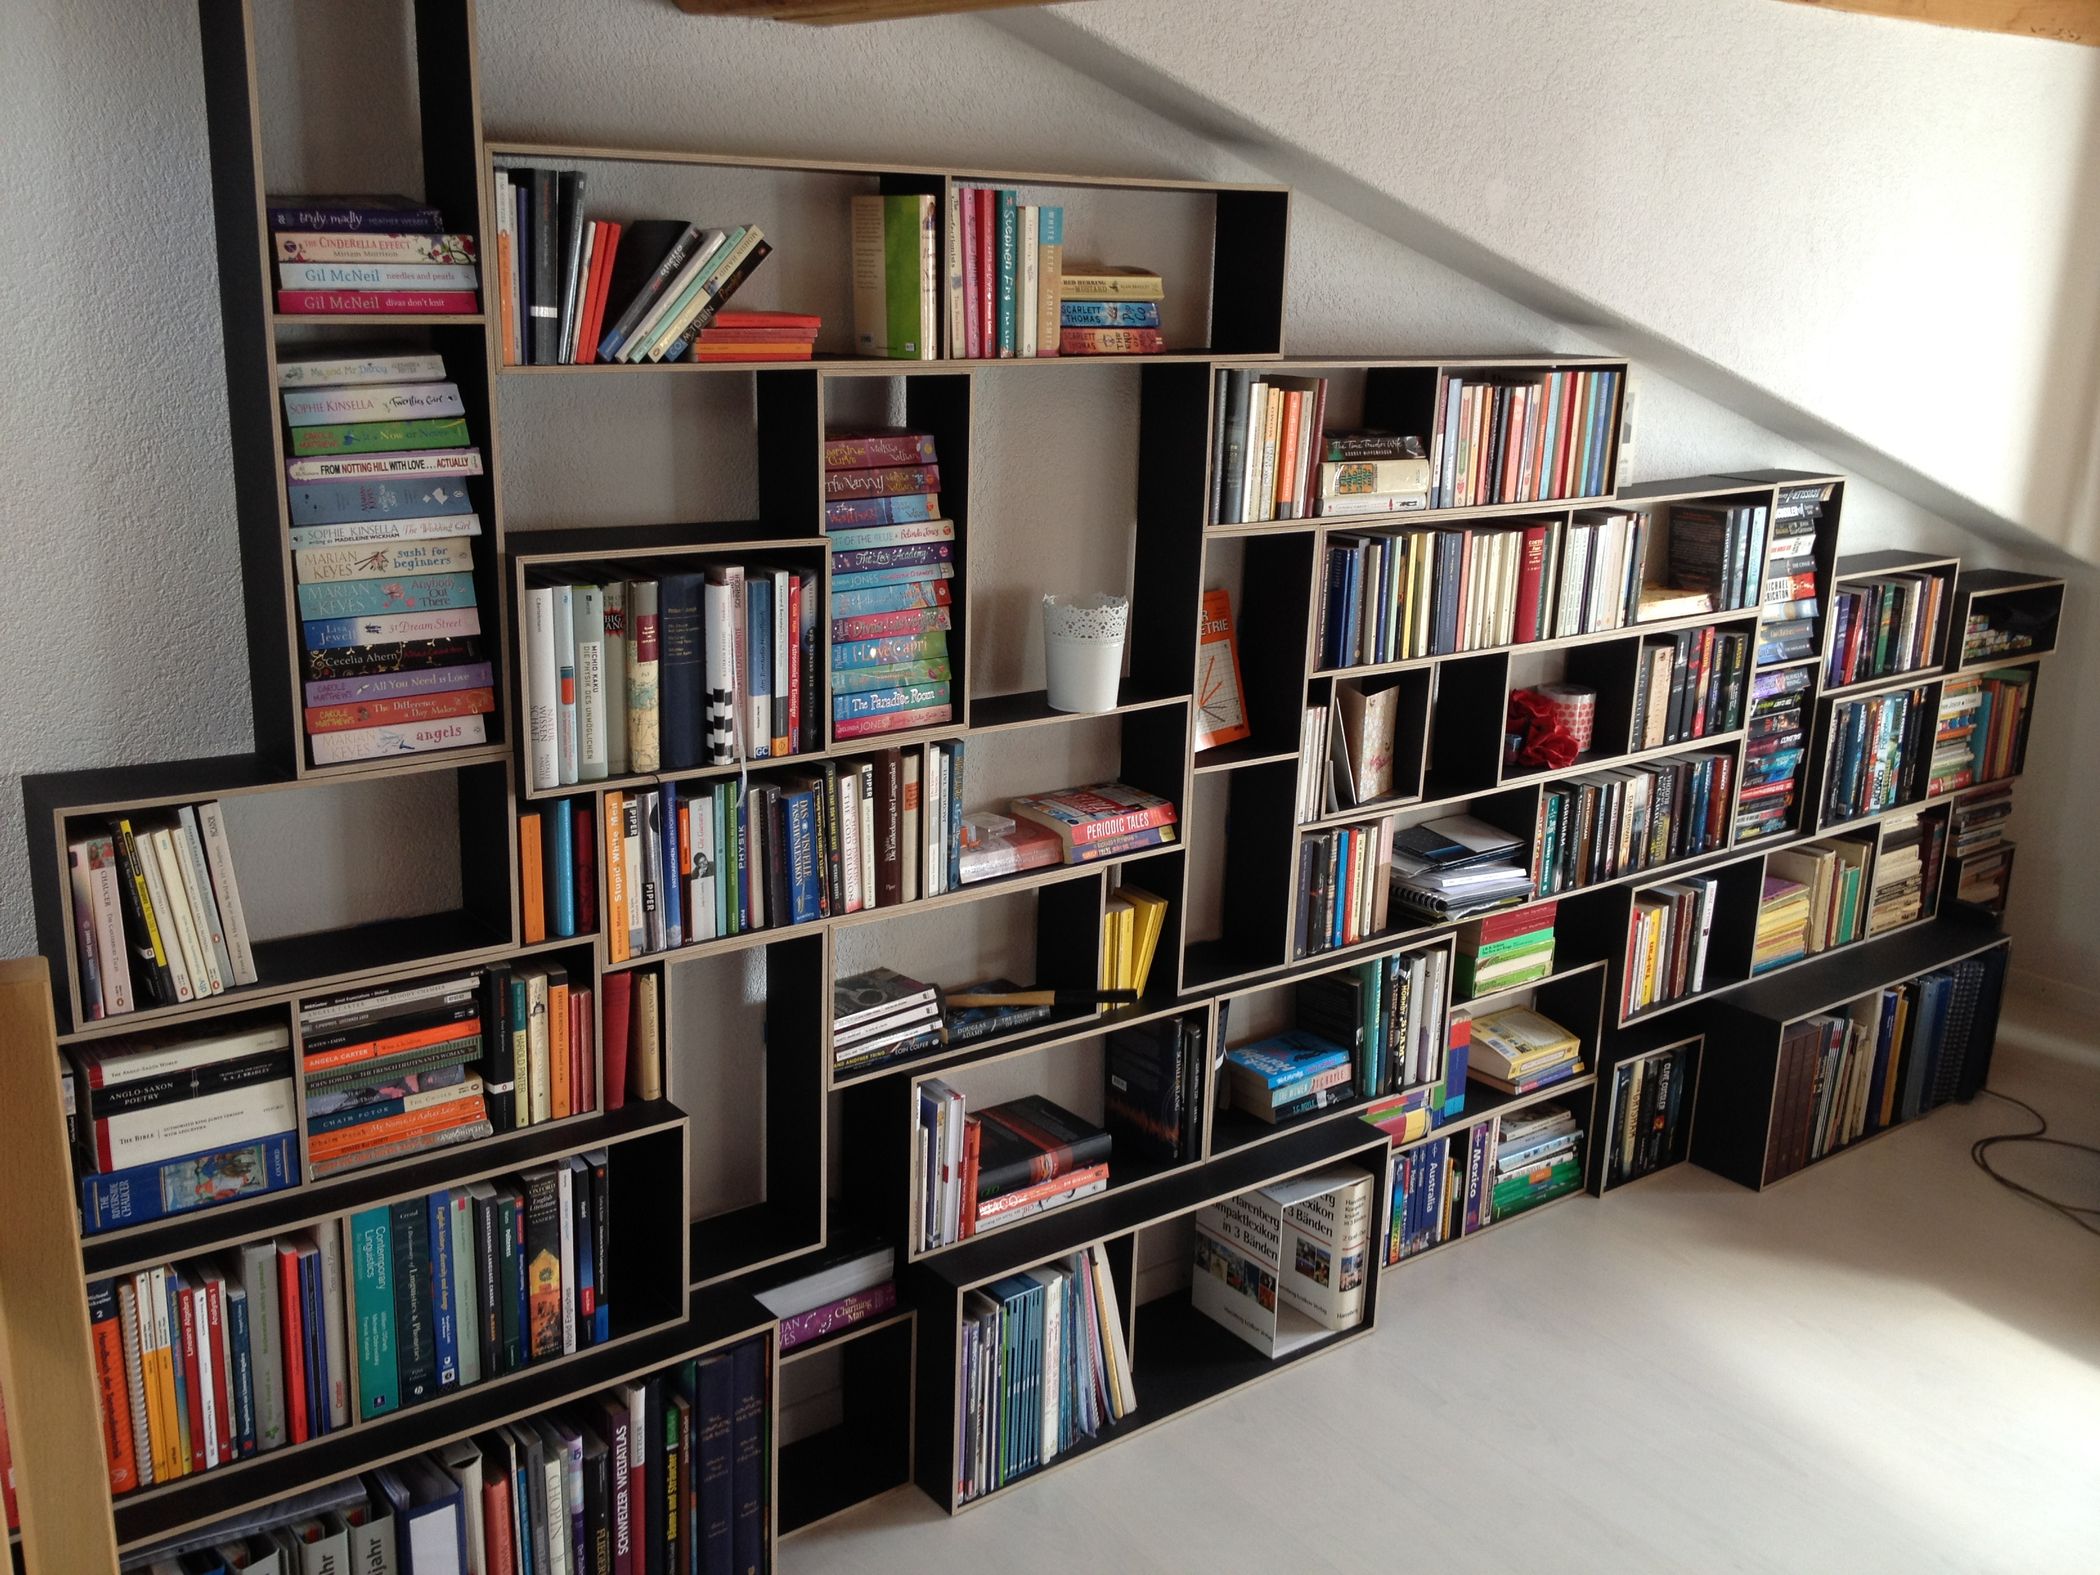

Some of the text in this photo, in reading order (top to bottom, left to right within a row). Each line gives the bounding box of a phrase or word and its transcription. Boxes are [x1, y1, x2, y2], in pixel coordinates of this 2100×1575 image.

[300, 211, 363, 229] truly madly
[1048, 211, 1056, 241] WHITE
[319, 237, 377, 249] CINDERELLA
[1003, 209, 1015, 301] Stephen Fry
[305, 269, 326, 282] Gil
[330, 268, 380, 282] McNeil
[416, 272, 429, 280] and
[304, 296, 325, 310] Gil
[329, 296, 380, 310] McNeil
[1061, 305, 1101, 314] SCARLETT
[1065, 315, 1101, 323] THOMAS
[290, 399, 375, 414] SOPHIE KINSELLA
[320, 464, 341, 475] FROM
[341, 463, 372, 473] NOTTING
[373, 462, 388, 472] HILL
[389, 461, 406, 471] WITH
[436, 457, 469, 468] ACTUALLY
[308, 524, 399, 539] SOPHIE KINSELLA
[304, 551, 358, 566] MARIAN
[397, 546, 447, 557] sushi for
[314, 564, 353, 580] KEYES
[393, 556, 451, 571] beginners
[850, 575, 880, 588] JONES
[308, 583, 370, 600] MARIAN
[319, 600, 366, 617] KEYES
[400, 619, 434, 633] Dream
[604, 614, 622, 623] BIG
[326, 624, 348, 634] Lisa
[326, 651, 398, 667] Cecelia Ahern
[584, 658, 592, 688] PHYSIK
[373, 682, 387, 692] All
[389, 679, 408, 690] You
[411, 675, 437, 687] Need
[852, 698, 869, 712] The
[870, 691, 910, 710] Paradise
[531, 704, 540, 743] SCHAFT
[416, 725, 463, 743] angels
[755, 747, 769, 757] GC
[610, 802, 619, 826] Men
[628, 808, 638, 837] PIPER
[1086, 812, 1149, 840] PERIODIC TALES
[1561, 803, 1570, 846] GRISHAM
[1624, 812, 1632, 843] BROWN
[738, 824, 746, 870] PHYSIK
[800, 800, 812, 878] DAS VISUELLE
[101, 870, 111, 907] CHAUCER
[615, 865, 623, 902] Stupid
[645, 883, 655, 912] PIPER
[957, 1022, 987, 1035] DOUGLAS
[962, 1029, 984, 1039] ADAMS
[330, 1037, 346, 1045] EMMA
[1399, 1019, 1407, 1057] SLAM
[309, 1049, 369, 1067] ANGELA CARTER
[848, 1050, 886, 1065] ANOTHER THING
[310, 1080, 328, 1089] JOHN
[441, 1050, 465, 1060] WOMAN
[1326, 1069, 1345, 1085] BOYLE
[124, 1092, 160, 1106] POETRY
[1301, 1099, 1316, 1112] BOYLE
[322, 1106, 389, 1128] CHAIM POTOK
[1629, 1092, 1641, 1141] GRISHAM
[120, 1132, 155, 1146] THE BIBLE
[1409, 1169, 1417, 1194] Poland
[1469, 1147, 1483, 1199] Mexico
[1426, 1162, 1438, 1213] Australia
[101, 1195, 109, 1211] THE
[112, 1181, 120, 1220] RIVERSIDE
[121, 1179, 131, 1217] CHAUCER
[1232, 1193, 1280, 1231] Harenberg
[1288, 1206, 1294, 1217] 3
[1296, 1209, 1333, 1238] Bänden
[1223, 1219, 1278, 1261] in 3 Bänden
[364, 1229, 374, 1278] Linguistics
[375, 1226, 386, 1290] Contemporary
[96, 1310, 104, 1319] 2
[211, 1295, 219, 1327] Analysis
[835, 1299, 873, 1318] Charming
[848, 1309, 865, 1323] Man
[181, 1295, 194, 1357] Lineare Algebra
[616, 1425, 629, 1557] SCHWEIZER WELTATLAS
